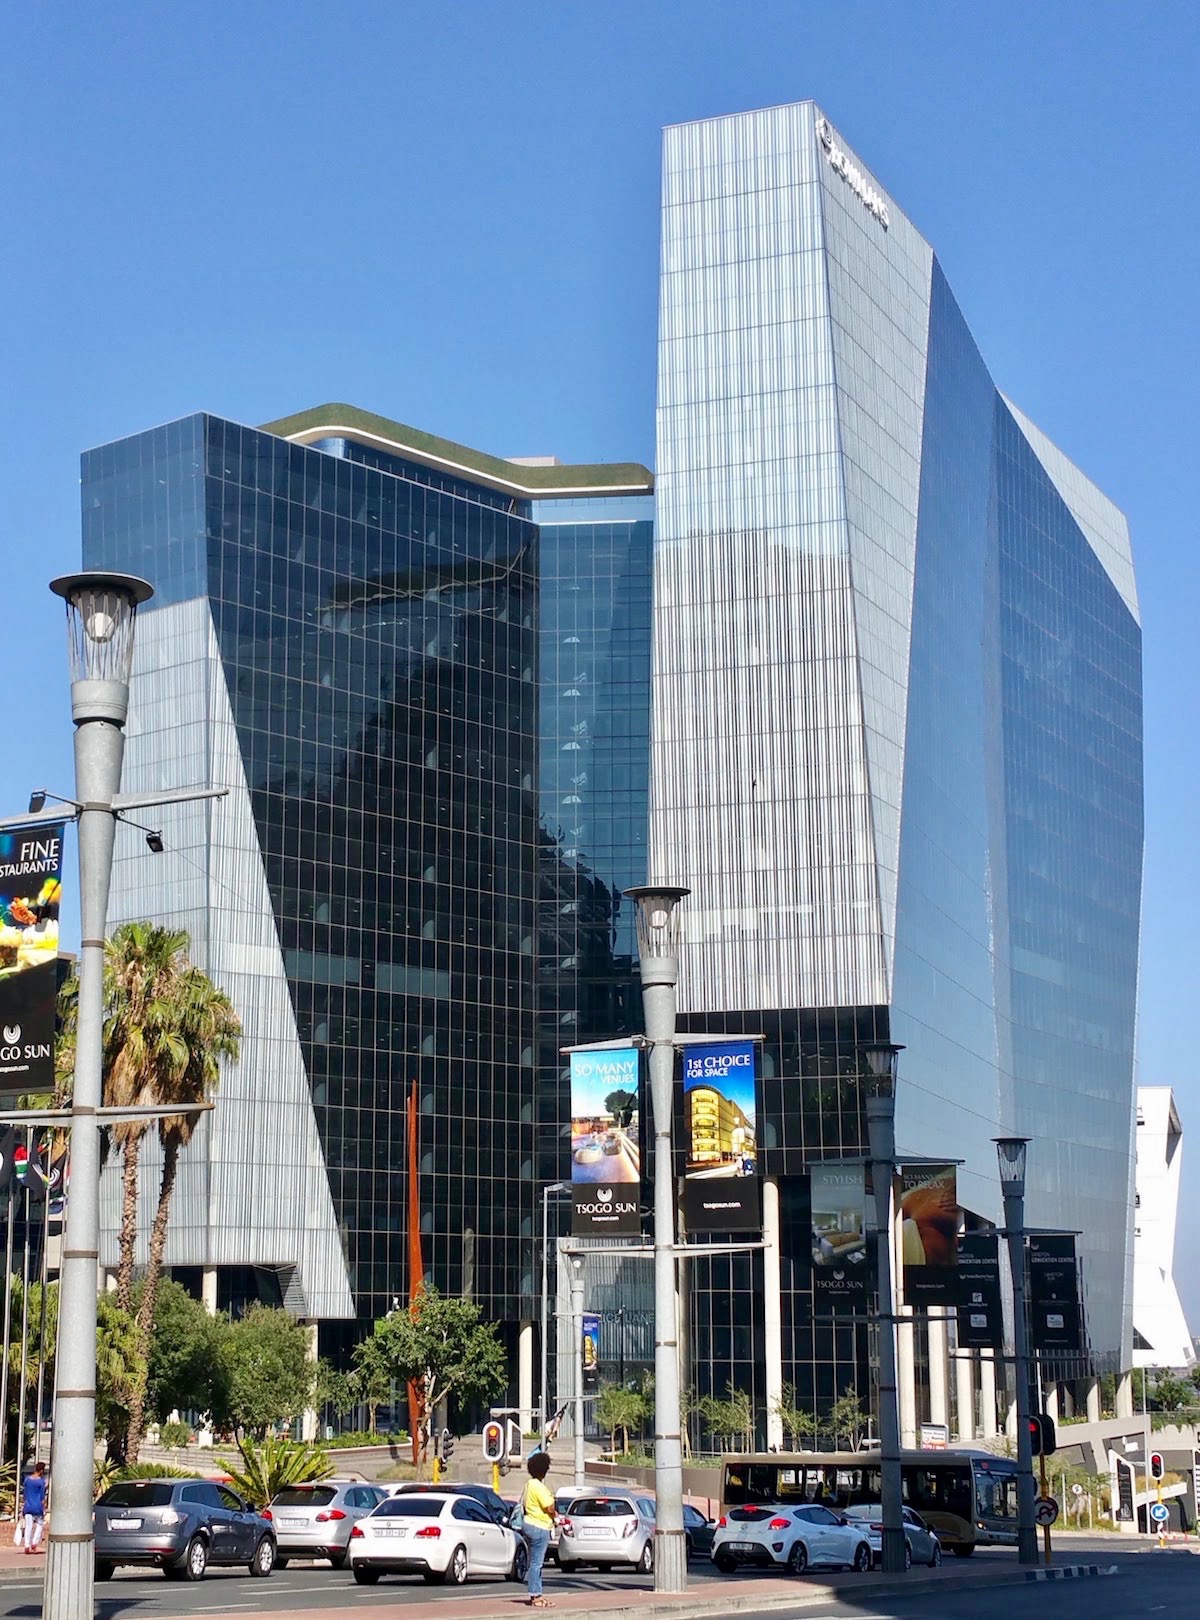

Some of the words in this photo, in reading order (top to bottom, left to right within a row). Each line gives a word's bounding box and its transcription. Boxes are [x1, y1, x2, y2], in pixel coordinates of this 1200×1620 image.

[20, 838, 60, 861] FINE
[0, 858, 59, 878] STAURANTS
[24, 1044, 50, 1059] SUN
[687, 1059, 703, 1069] 1st
[704, 1054, 751, 1068] CHOICE
[574, 1063, 592, 1078] SO
[596, 1061, 635, 1075] MANY
[687, 1069, 703, 1078] FOR
[704, 1067, 729, 1077] SPACE
[601, 1073, 635, 1084] VENUES
[822, 1175, 863, 1184] STYLISH
[903, 1180, 916, 1189] TO
[575, 1202, 613, 1214] TSOGO
[616, 1202, 638, 1213] SUN
[816, 1280, 845, 1289] TSOGO
[846, 1280, 864, 1289] SUN
